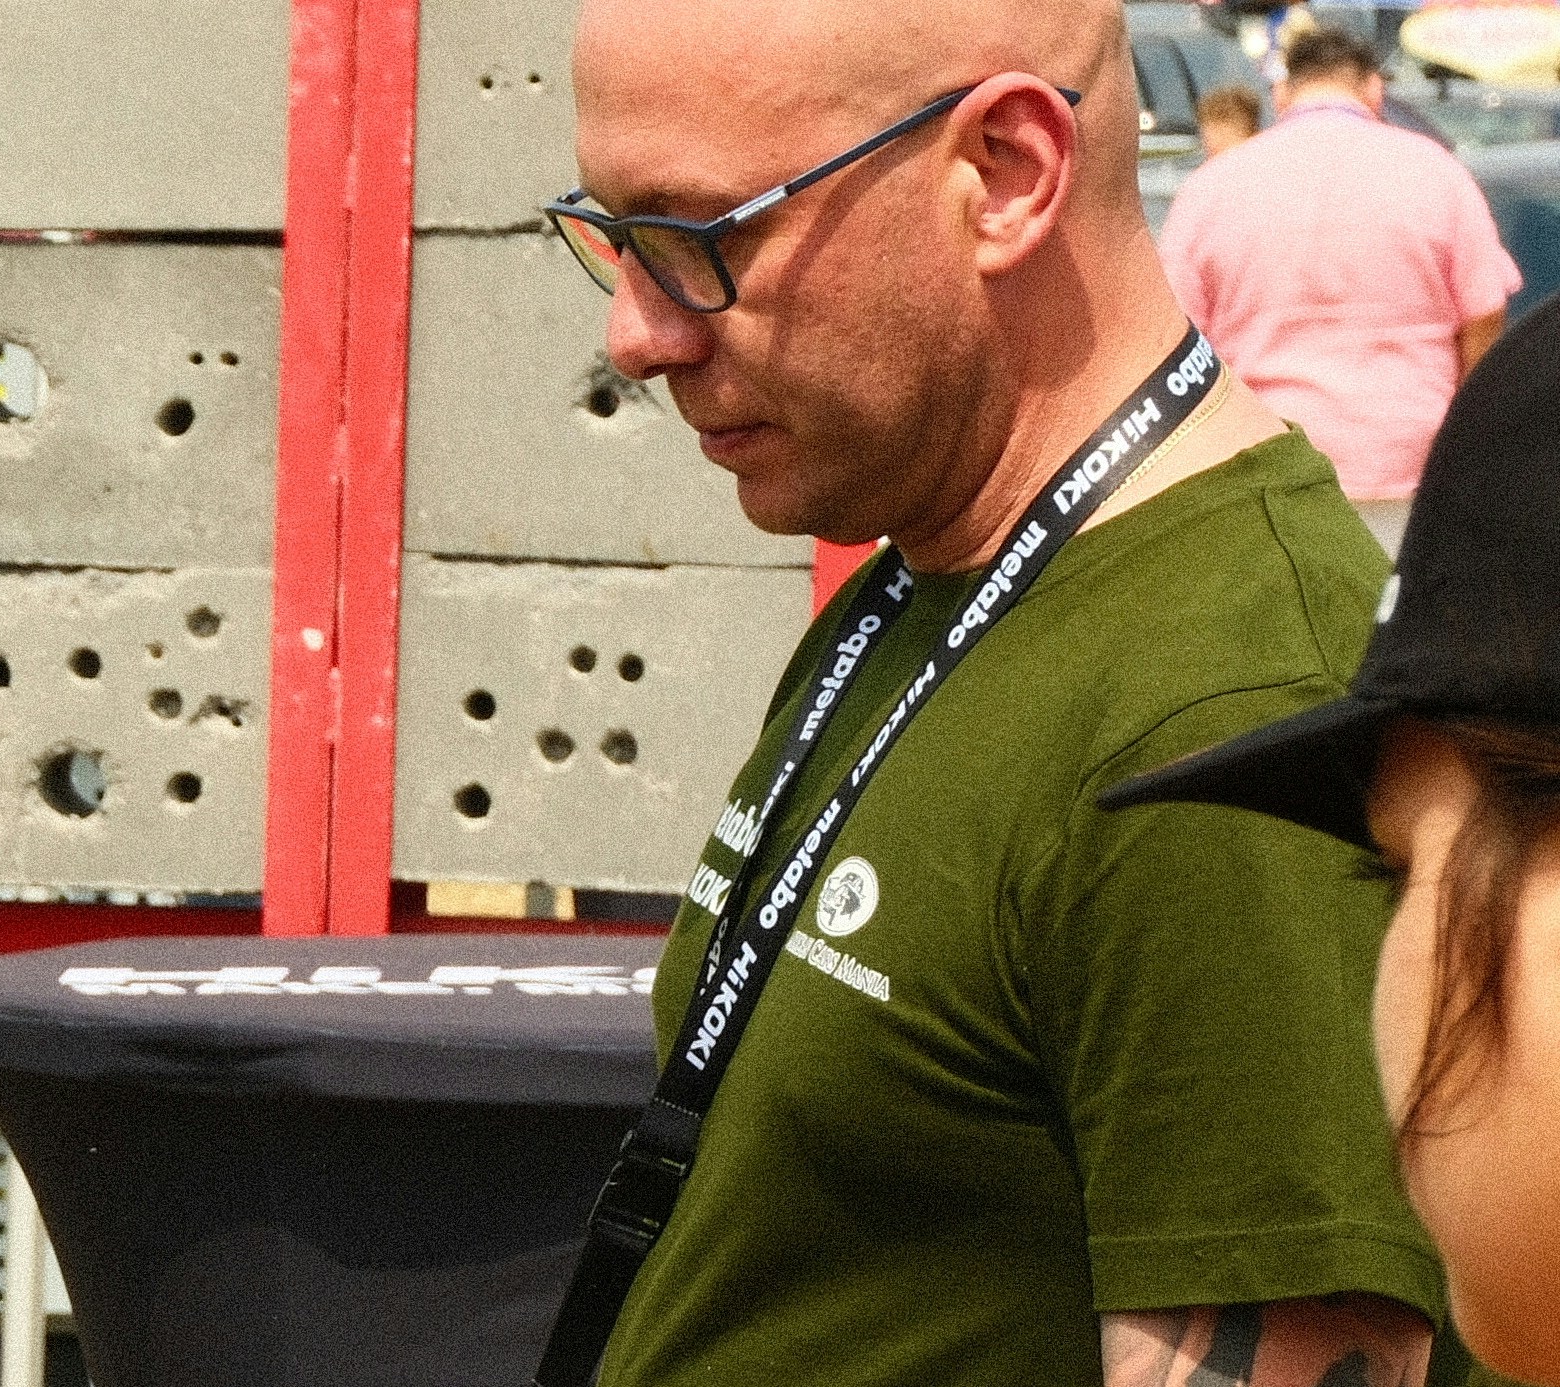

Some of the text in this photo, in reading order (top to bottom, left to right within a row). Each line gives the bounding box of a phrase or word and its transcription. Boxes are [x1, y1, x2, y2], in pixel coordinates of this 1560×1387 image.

[1051, 396, 1163, 515] HiKOKI
[947, 520, 1048, 650] metabo
[798, 614, 881, 742] metabo
[850, 660, 936, 788] HiKOKI
[759, 798, 842, 929] metabo
[684, 940, 758, 1072] HiKOKI
